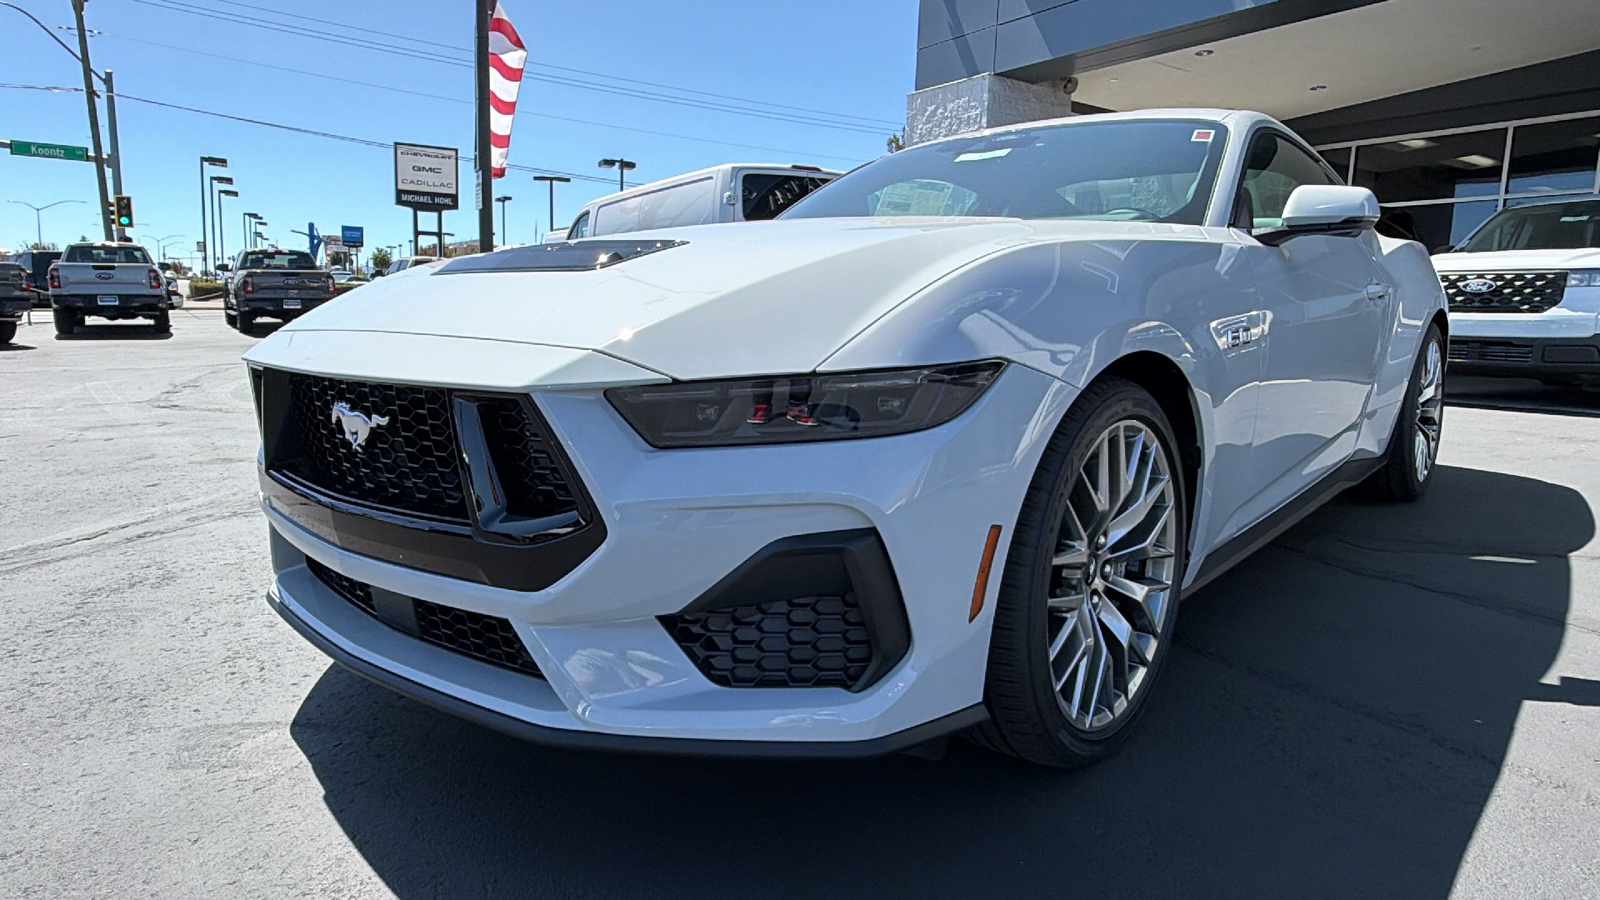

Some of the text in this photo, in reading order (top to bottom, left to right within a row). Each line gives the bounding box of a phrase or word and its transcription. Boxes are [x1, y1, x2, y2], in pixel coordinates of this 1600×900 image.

[31, 145, 65, 157] Koontz
[400, 151, 453, 160] CHEVROLET
[412, 165, 442, 174] GMC
[401, 178, 453, 189] CADILLAC
[401, 193, 454, 206] MICHAEL HOHL
